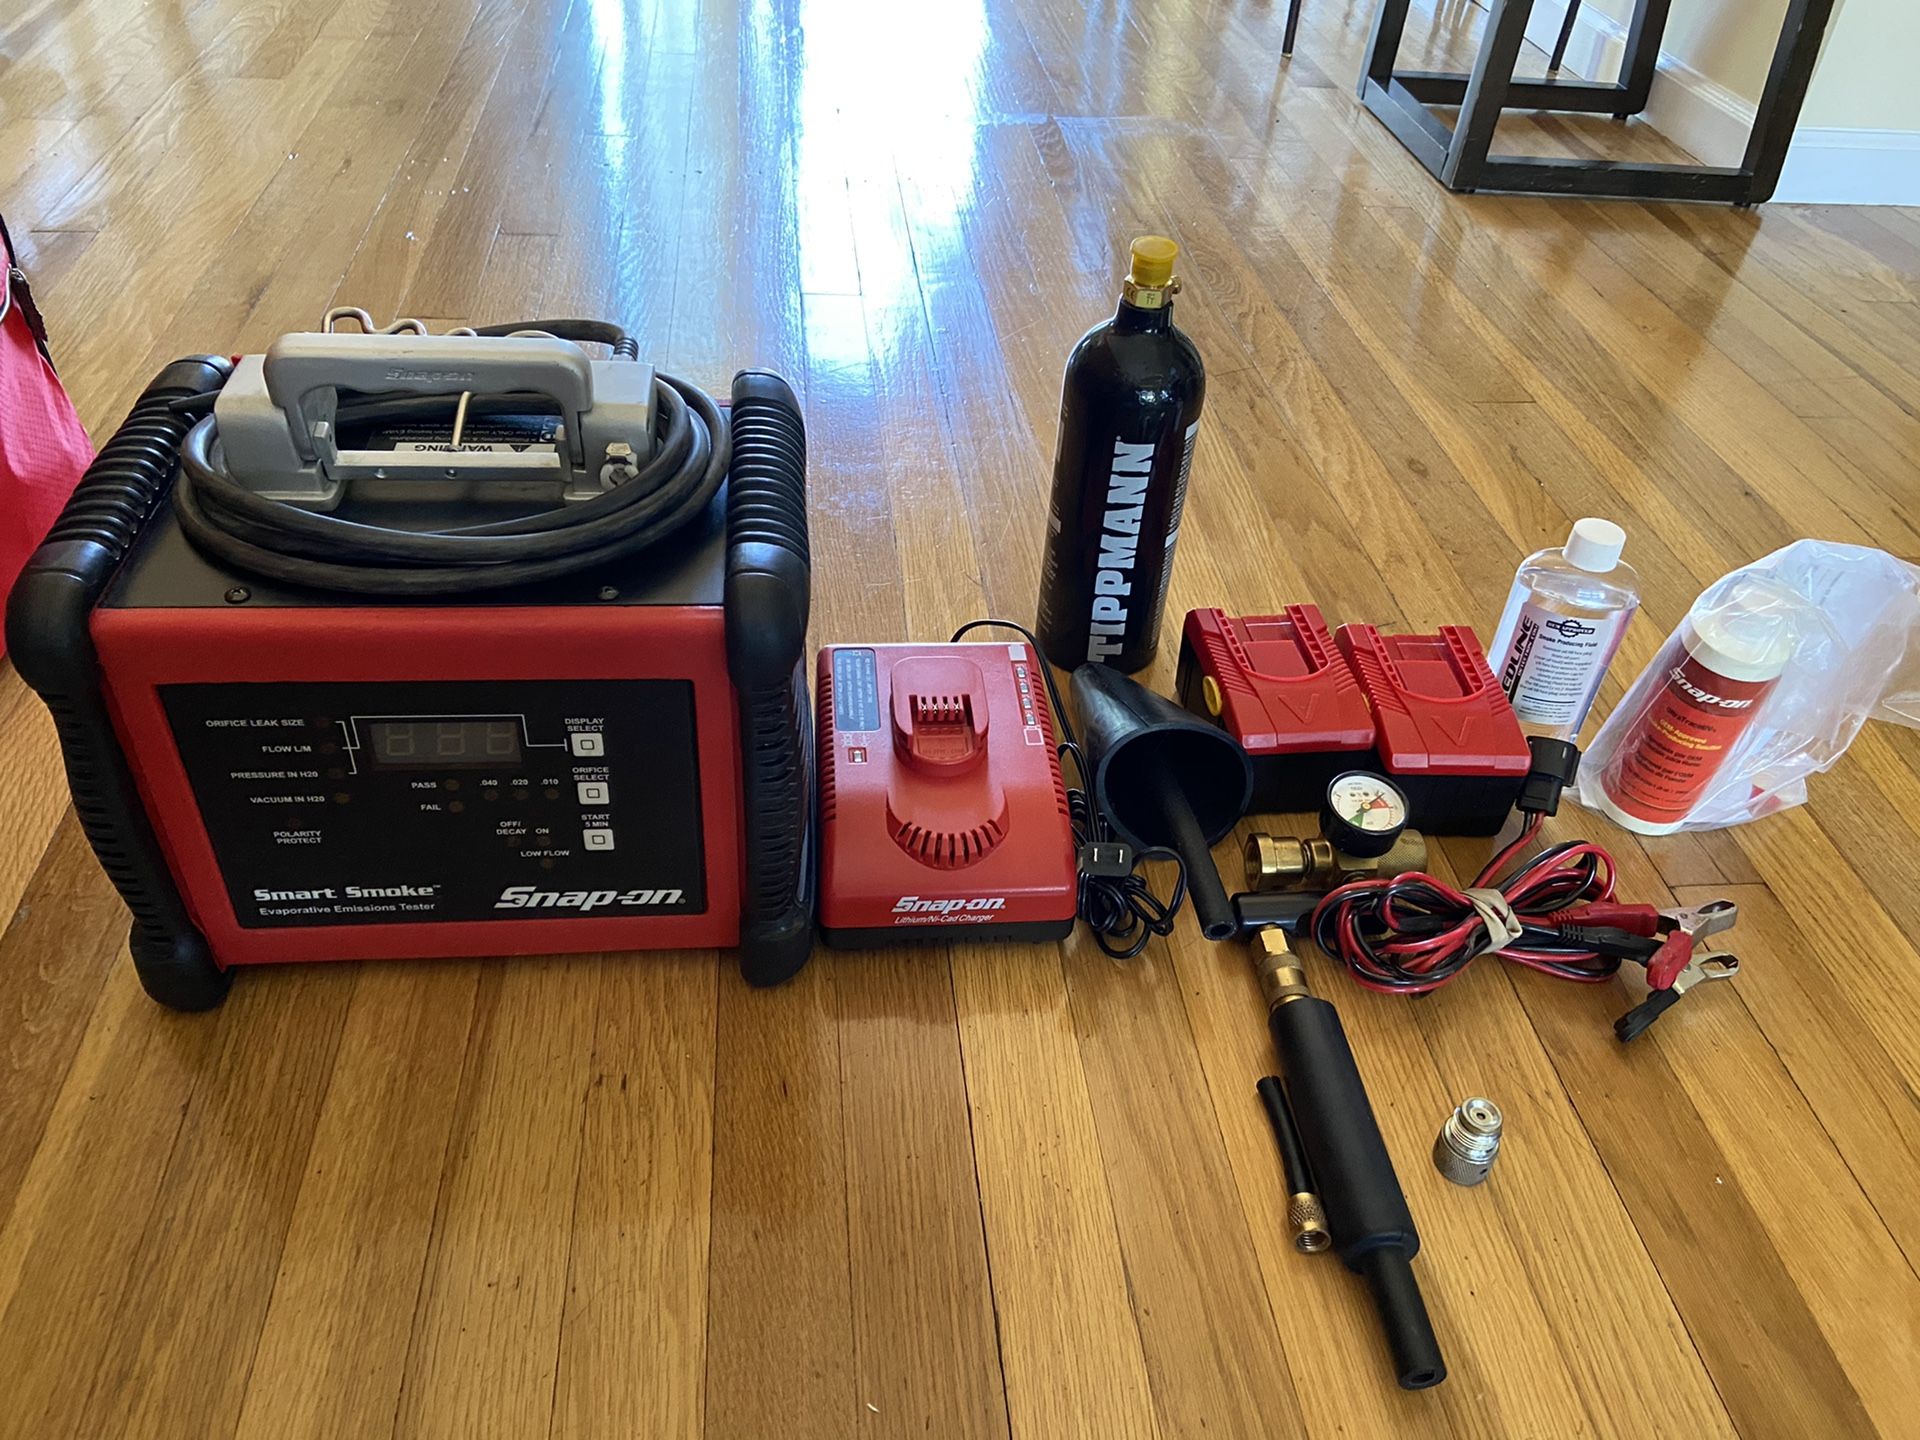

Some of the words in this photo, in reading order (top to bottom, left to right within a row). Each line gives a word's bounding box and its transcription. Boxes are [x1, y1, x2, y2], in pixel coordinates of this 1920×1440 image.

[1086, 441, 1155, 663] TIPPMANN
[1538, 633, 1556, 643] Smoke
[1557, 639, 1584, 648] Producing
[1502, 614, 1533, 696] EDLINE
[1668, 667, 1753, 710] Snap-on
[205, 719, 248, 727] ORIFICE
[250, 719, 279, 727] LEAK
[281, 718, 305, 726] SIZE
[262, 745, 292, 753] FLOW
[293, 745, 312, 753] L/M
[572, 766, 609, 774] ORIFICE
[230, 771, 286, 779] PRESSURE
[510, 778, 529, 786] .020
[250, 796, 293, 804] VACUUM
[581, 813, 610, 821] START
[273, 830, 321, 838] POLARITY
[496, 828, 527, 836] DECAY
[254, 887, 338, 901] Smart
[494, 886, 683, 911] Snap-on
[259, 905, 332, 917] Evaporative
[334, 904, 396, 913] Emissions
[399, 902, 436, 911] Tester
[891, 896, 1005, 914] Snap-on
[960, 914, 995, 923] Charger
